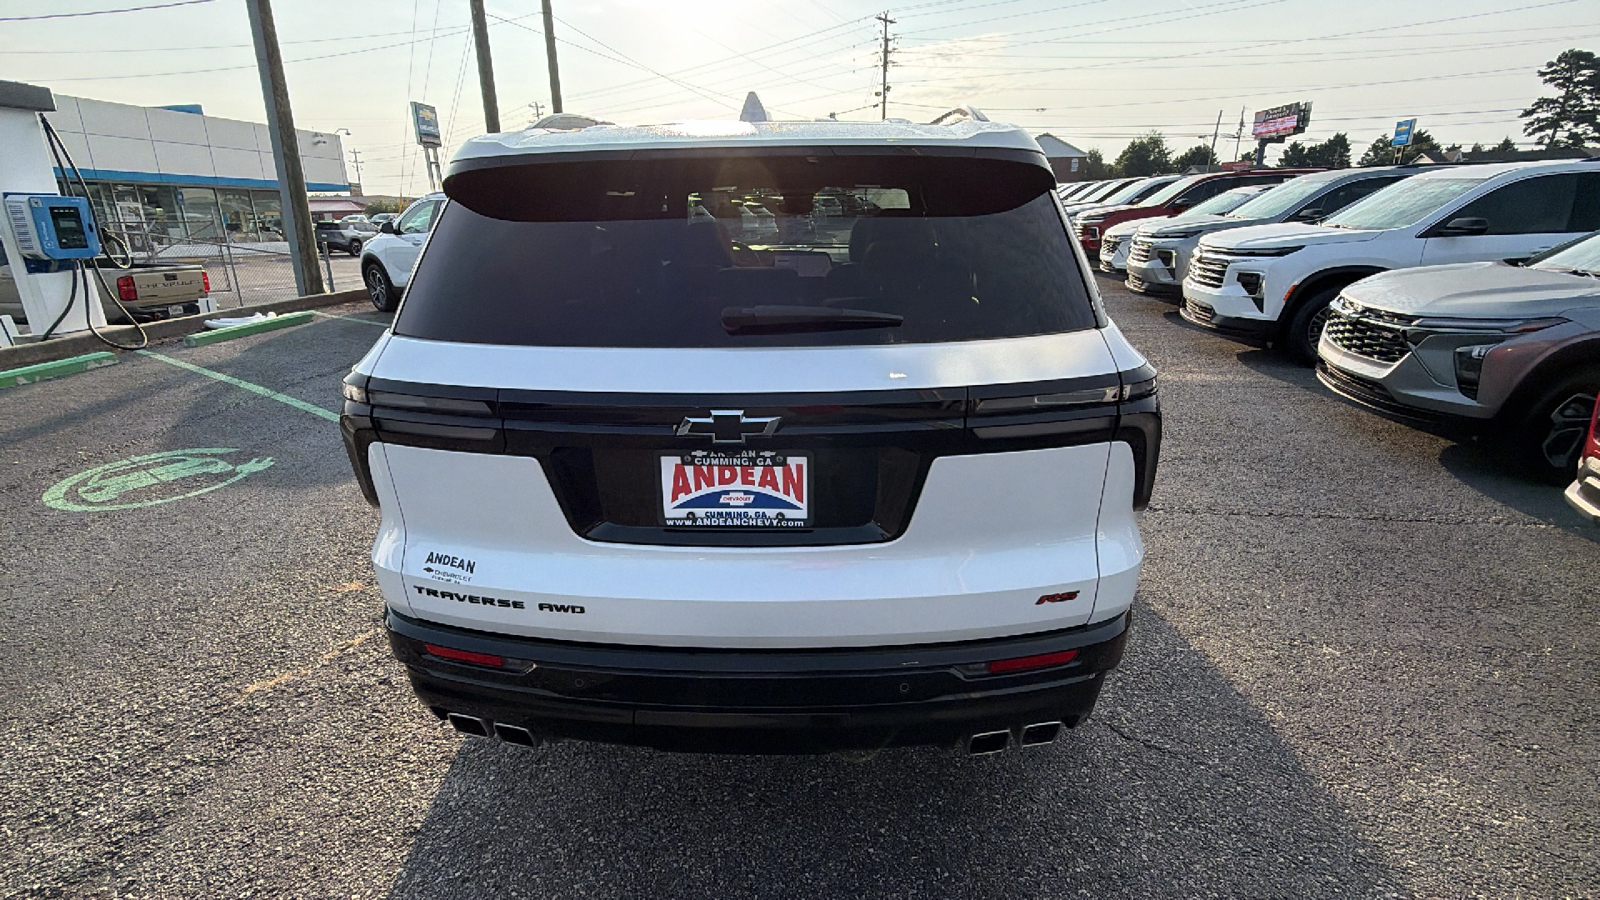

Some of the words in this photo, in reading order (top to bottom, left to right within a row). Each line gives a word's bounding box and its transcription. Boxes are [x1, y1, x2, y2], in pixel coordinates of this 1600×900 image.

[694, 458, 753, 466] CUMMING,
[756, 458, 773, 466] GA
[671, 463, 804, 504] ANDEAN
[665, 518, 804, 527] www.ANDEANCHEVY.com
[425, 551, 476, 575] ANDEAN
[434, 569, 472, 582] CHEVROLET
[413, 584, 526, 610] TRAVERSE
[538, 602, 586, 614] AWD
[1035, 590, 1080, 605] RS
